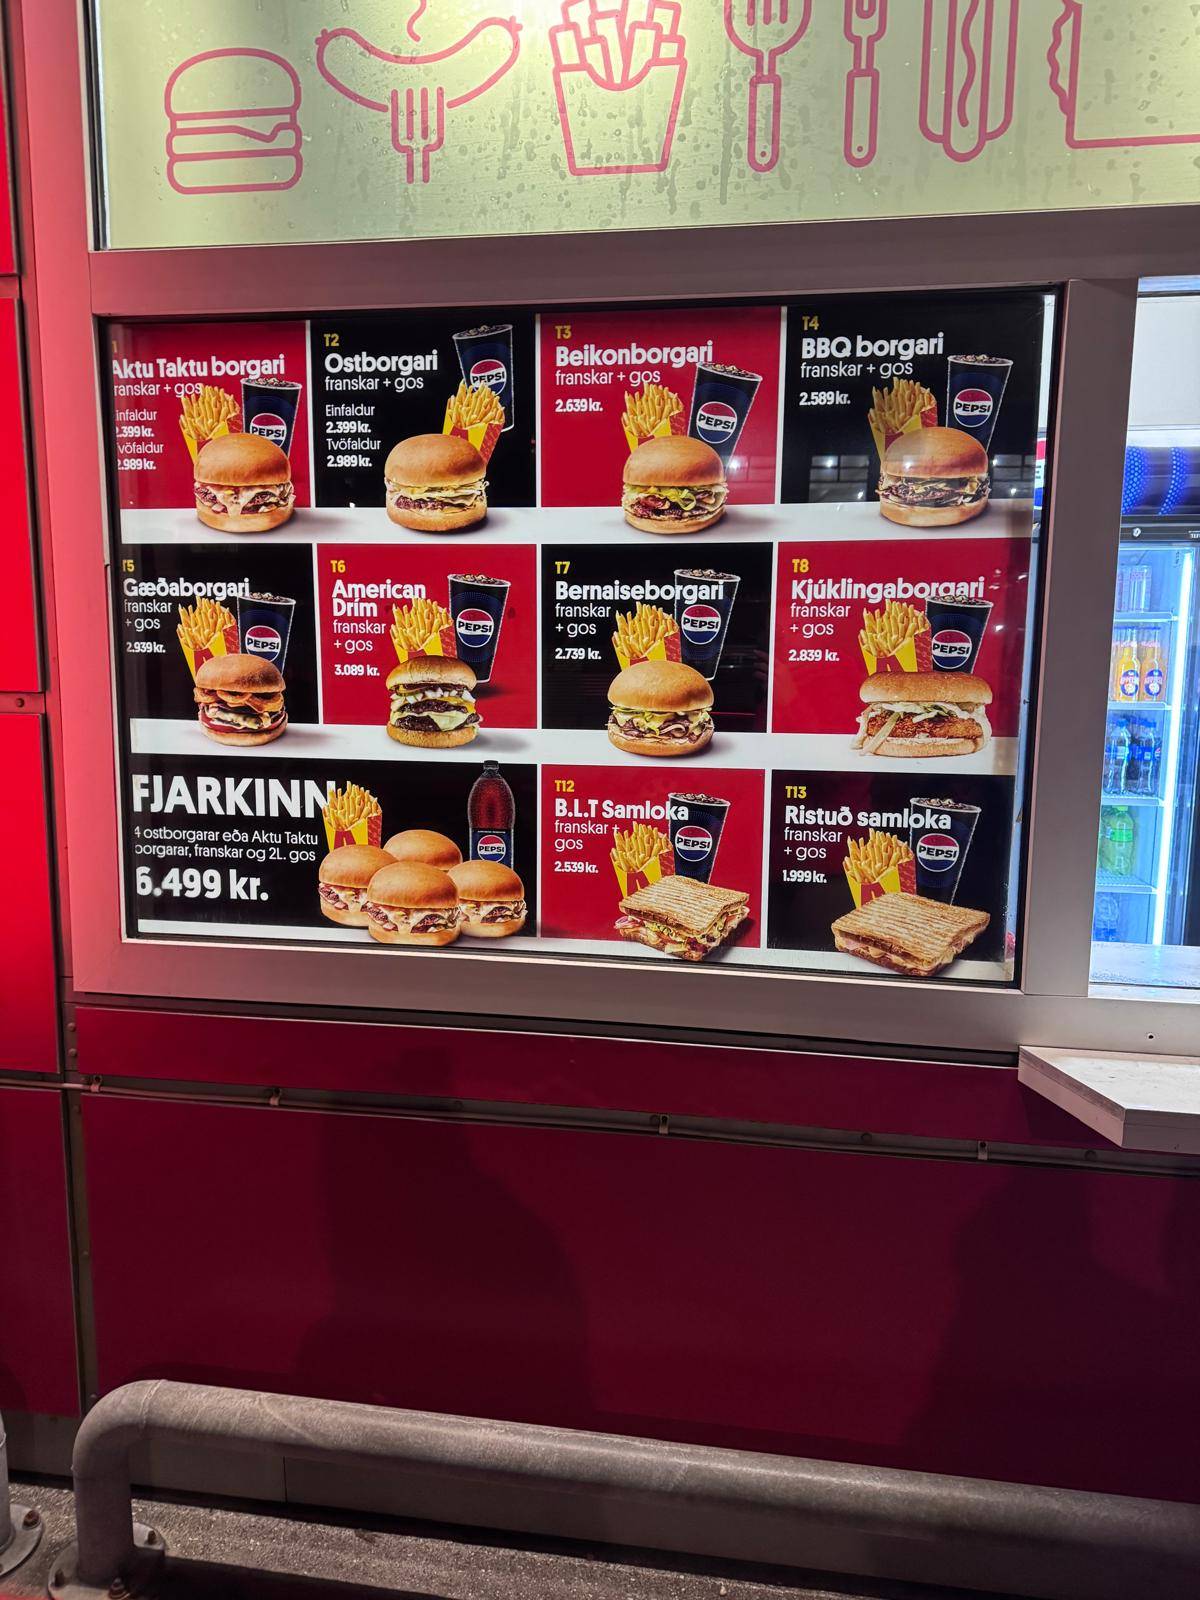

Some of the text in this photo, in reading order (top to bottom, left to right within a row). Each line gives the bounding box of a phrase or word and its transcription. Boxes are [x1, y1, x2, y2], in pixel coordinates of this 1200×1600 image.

[802, 316, 819, 330] T4
[555, 325, 572, 339] T3
[324, 334, 340, 346] T2
[802, 332, 944, 360] BBQ borgari
[556, 340, 713, 368] Beikonborgari
[112, 354, 285, 380] Aktu Taktu borgari
[324, 350, 438, 376] Ostborgari
[801, 362, 861, 378] franskar
[880, 361, 913, 379] gos
[325, 376, 379, 391] franskar
[394, 376, 424, 392] gos
[472, 372, 504, 383] PEPSI
[556, 369, 614, 385] franskar
[629, 370, 661, 386] gos
[114, 380, 160, 396] ranskar
[174, 382, 202, 398] gos
[116, 408, 158, 421] infaldur
[326, 404, 375, 416] Einfaldur
[955, 402, 991, 414] PEPSI
[698, 414, 735, 430] PEPSI
[252, 426, 284, 438] PEPSI
[116, 441, 164, 454] vöfaldur
[326, 438, 381, 450] Tvöfaldur
[330, 560, 346, 573] T6
[555, 561, 570, 574] T7
[792, 558, 810, 573] T8
[124, 577, 250, 600] Gæðaborgari
[332, 579, 426, 599] American
[555, 580, 724, 604] Bernaiseborgari
[791, 576, 984, 604] Kjúklingaborgari
[124, 599, 172, 613] franskar
[333, 596, 377, 617] Drím
[555, 603, 611, 618] franskar
[791, 602, 851, 618] franskar
[134, 618, 160, 632] gos
[333, 620, 386, 634] franskar
[458, 622, 492, 632] PEPSI
[567, 623, 596, 637] gos
[683, 617, 719, 629] PEPSI
[802, 622, 834, 638] gos
[248, 638, 279, 650] PEPSI
[345, 639, 373, 654] gos
[932, 644, 970, 655] PEPSI
[555, 648, 602, 660] 2.739 kr.
[788, 649, 840, 662] 2.839 kr.
[335, 664, 380, 676] 3.089 kr.
[554, 780, 574, 792] T12
[785, 786, 806, 799] T13
[132, 774, 336, 818] FJARKINN
[555, 798, 689, 820] B.L.T Samloka
[785, 805, 951, 830] Ristuð samloka
[554, 820, 608, 834] franskar
[134, 826, 318, 845] 4 ostborgarar eða Aktu Taktu
[784, 828, 842, 842] franskar
[554, 838, 583, 852] gos
[677, 837, 710, 848] PEPSI
[194, 844, 243, 858] franskar
[246, 849, 265, 863] og
[289, 849, 316, 863] gos
[796, 847, 826, 861] gos
[919, 847, 956, 858] PEPSI
[136, 866, 269, 901] 6.499 kr.
